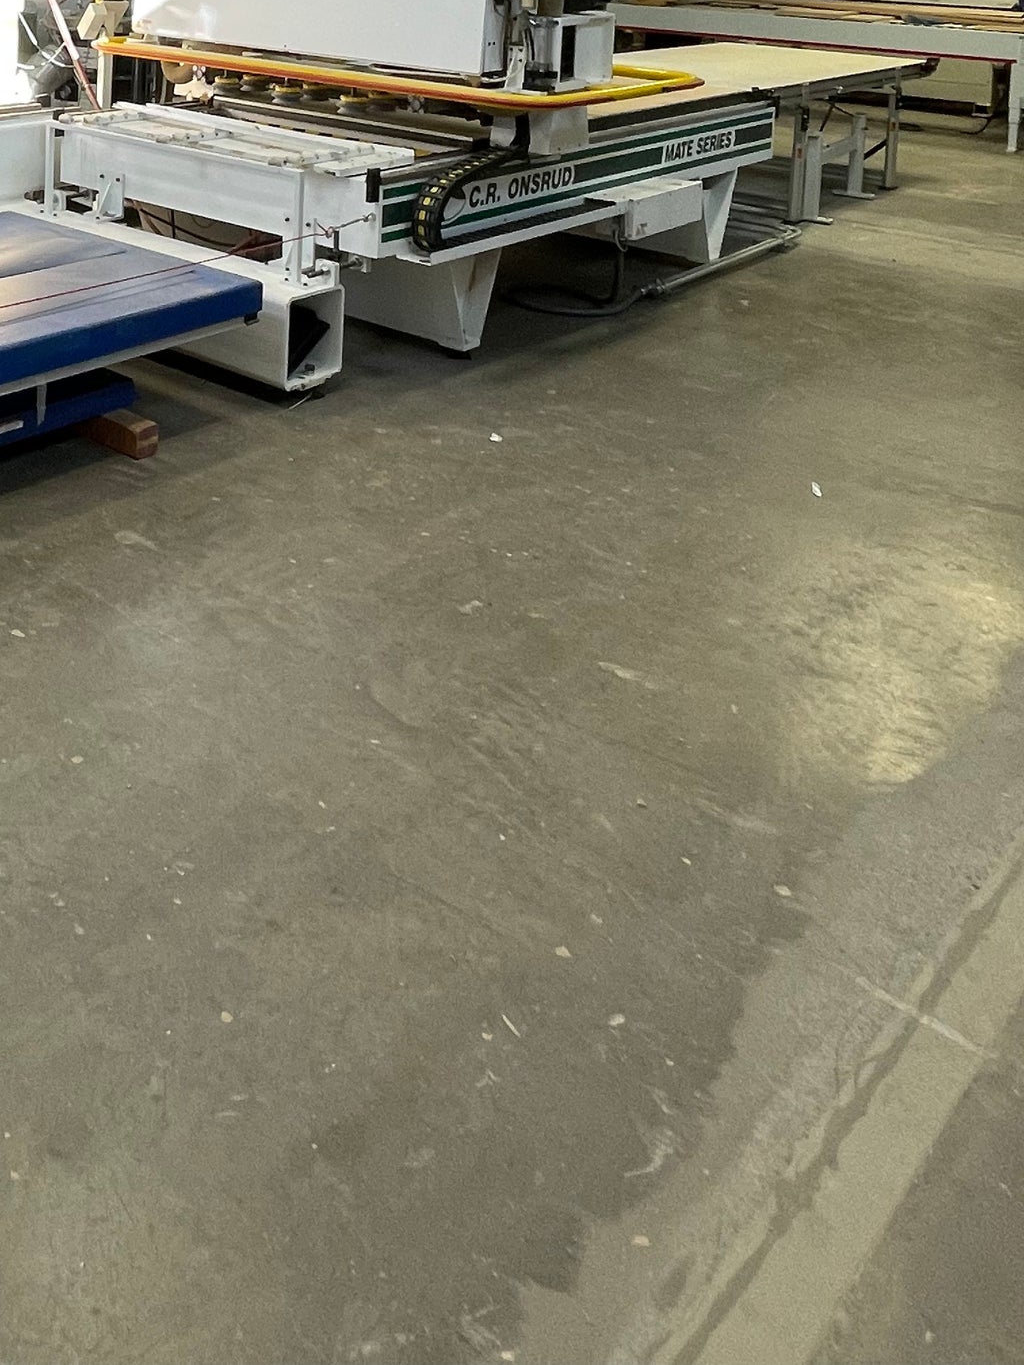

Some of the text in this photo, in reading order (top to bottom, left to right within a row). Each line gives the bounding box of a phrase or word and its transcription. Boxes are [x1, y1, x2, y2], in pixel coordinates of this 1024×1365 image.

[664, 131, 733, 163] MATE SERIES
[469, 166, 573, 208] C.R. ONSRUD
